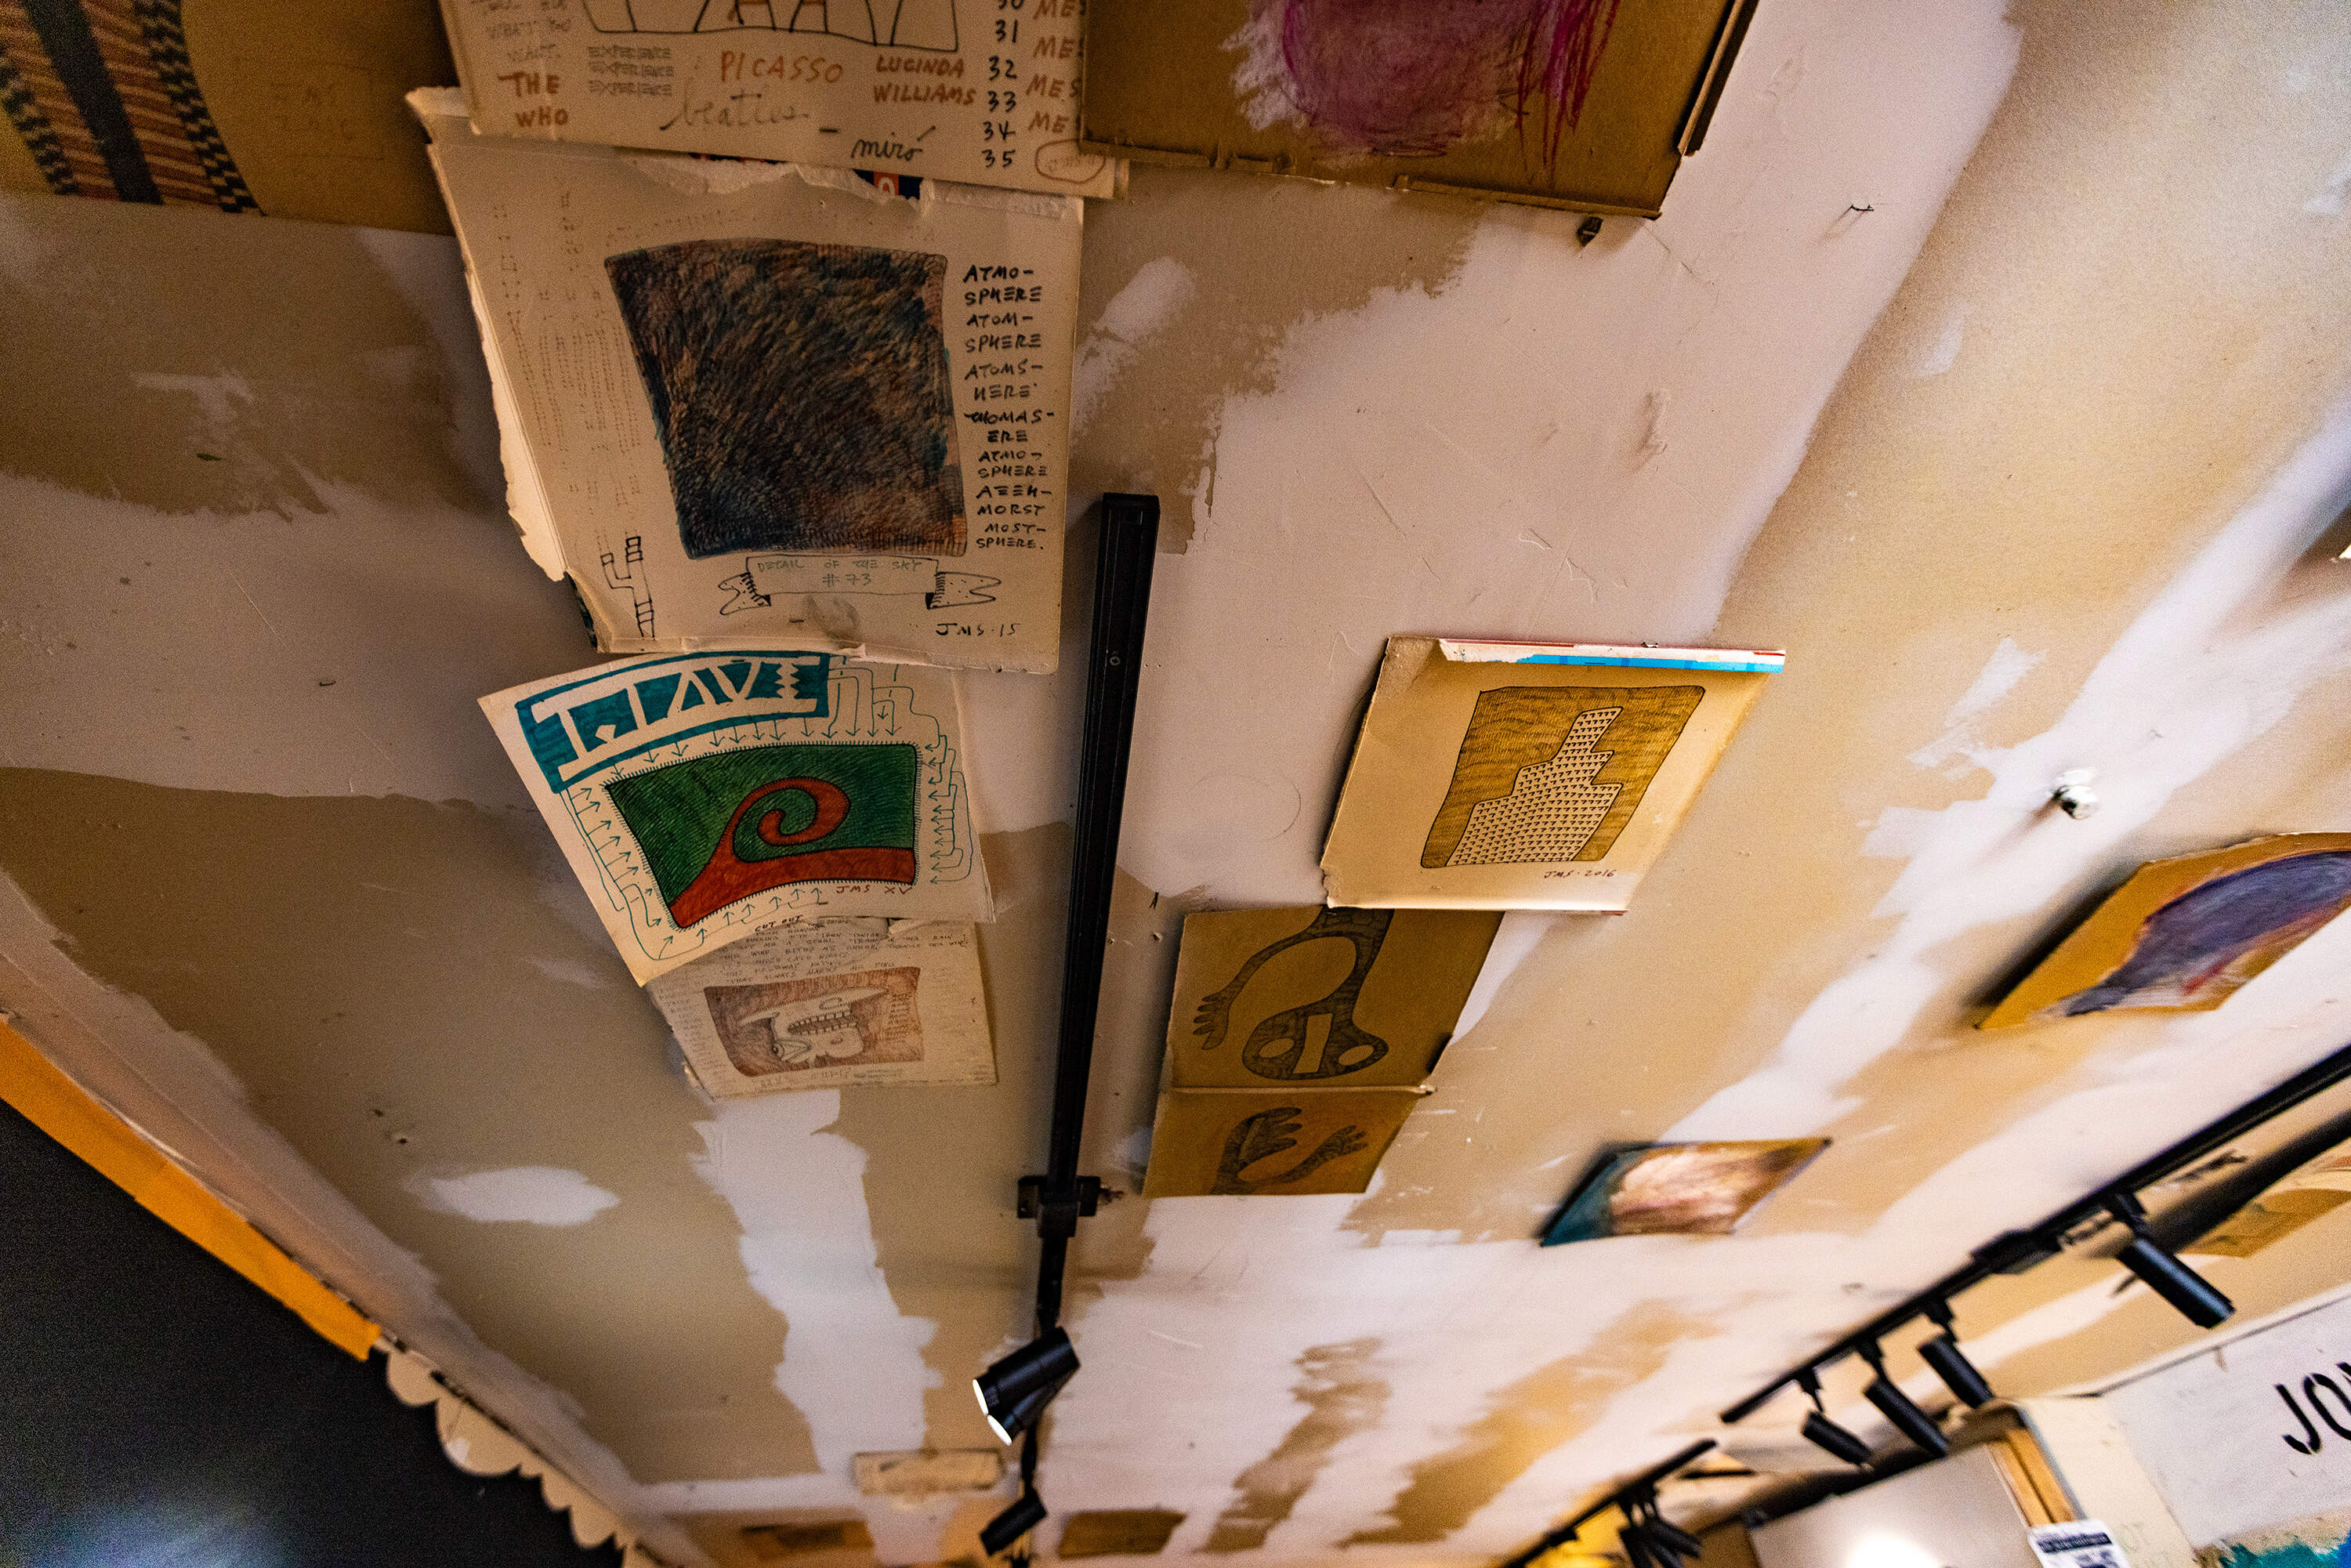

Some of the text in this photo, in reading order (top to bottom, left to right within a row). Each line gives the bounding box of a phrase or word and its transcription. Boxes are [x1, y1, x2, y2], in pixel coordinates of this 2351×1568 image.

[995, 20, 1018, 43] 31
[720, 49, 844, 83] PICASSO
[875, 54, 965, 78] LUCINDA
[989, 55, 1017, 81] 32
[497, 69, 560, 97] THE
[874, 81, 976, 106] WILLIAMS
[987, 90, 1017, 113] 33
[515, 106, 568, 127] WHO
[983, 120, 1016, 141] 34
[981, 148, 1016, 168] 35
[962, 264, 1034, 283] ATMO-
[963, 285, 1042, 306] SPHERE
[965, 312, 1034, 328] ATOM-
[964, 333, 1041, 353] SPHERE
[987, 429, 1028, 444] ERE
[977, 465, 1048, 479] SPHERE
[976, 504, 1046, 516] MORST
[984, 523, 1046, 534] MOST-
[757, 558, 804, 573] DETAIL
[824, 557, 840, 569] OF
[892, 559, 922, 572] SKY
[835, 884, 913, 895] JMS XV
[755, 921, 777, 932] CUT
[781, 914, 803, 924] OUT
[2274, 1360, 2351, 1455] JO
